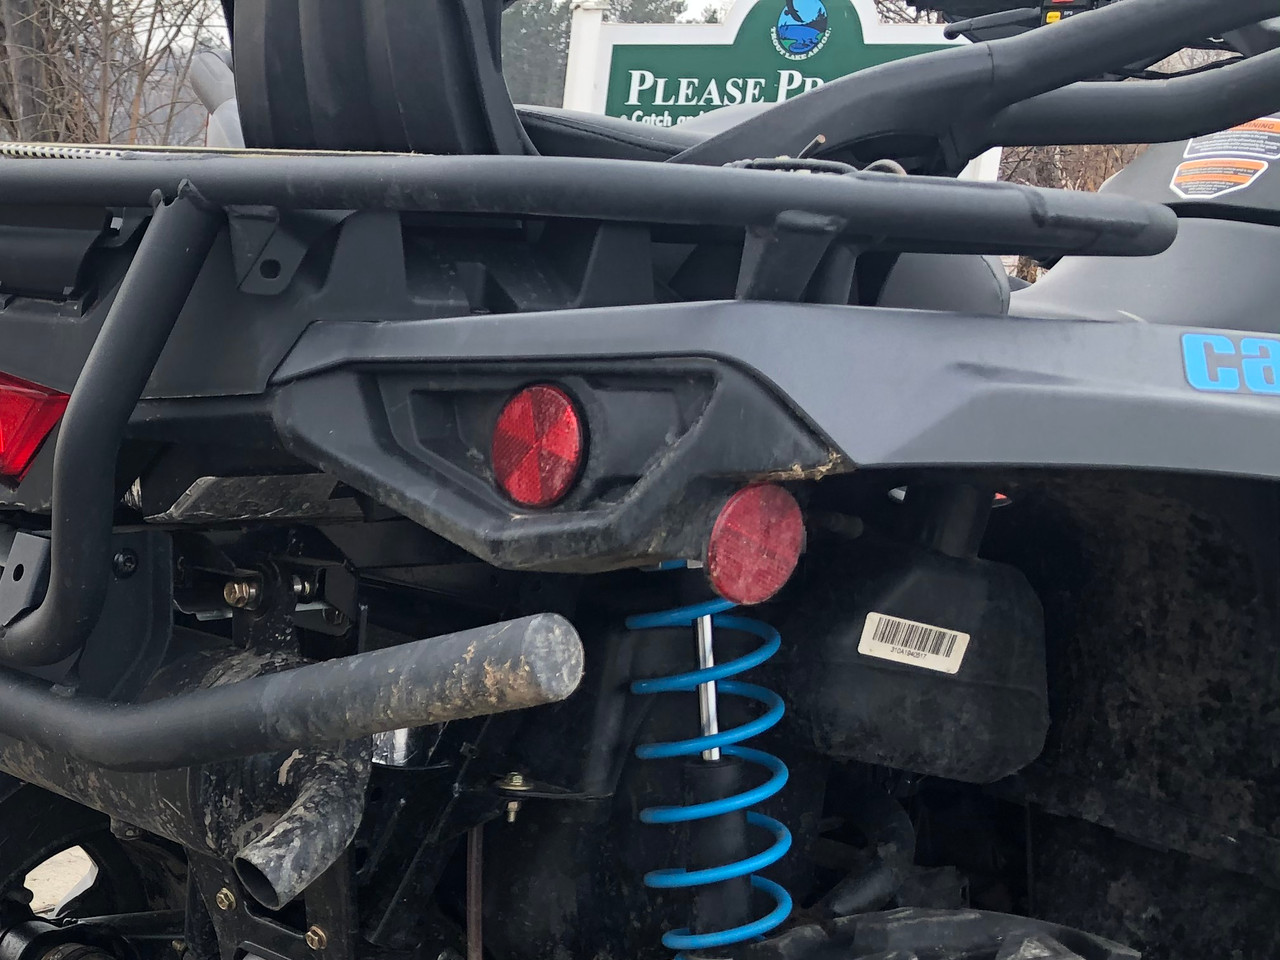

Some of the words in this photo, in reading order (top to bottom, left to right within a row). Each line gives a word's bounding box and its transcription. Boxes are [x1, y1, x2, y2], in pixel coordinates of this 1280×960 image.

[784, 52, 808, 61] LAKE
[624, 69, 766, 106] PLEASE
[631, 109, 671, 127] Catch
[1181, 332, 1280, 394] ca
